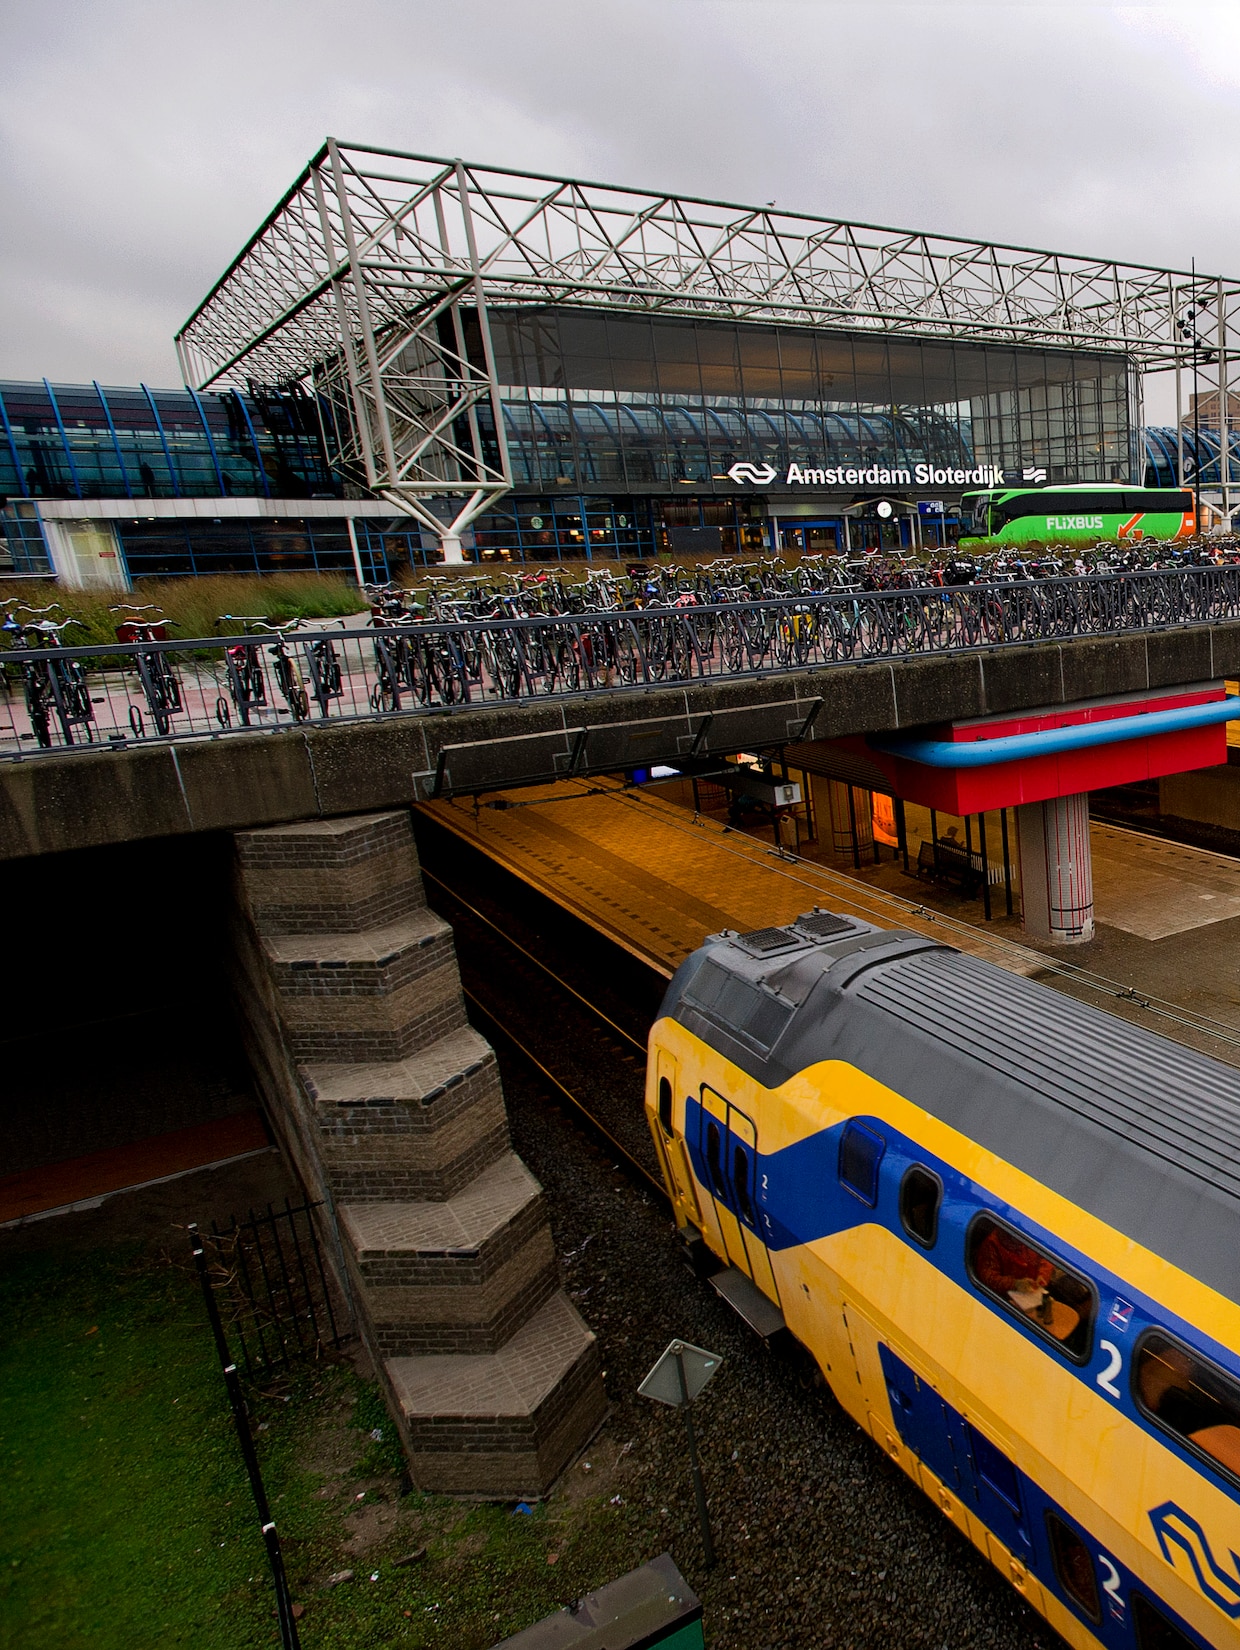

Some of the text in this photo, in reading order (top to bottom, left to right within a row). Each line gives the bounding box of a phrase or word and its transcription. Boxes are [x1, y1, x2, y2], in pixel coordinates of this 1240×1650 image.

[786, 463, 1005, 489] Amsterdam Sloterdijk
[761, 1173, 769, 1190] 2
[763, 1213, 772, 1229] 2
[1096, 1339, 1122, 1400] 2
[1098, 1553, 1126, 1608] 2
